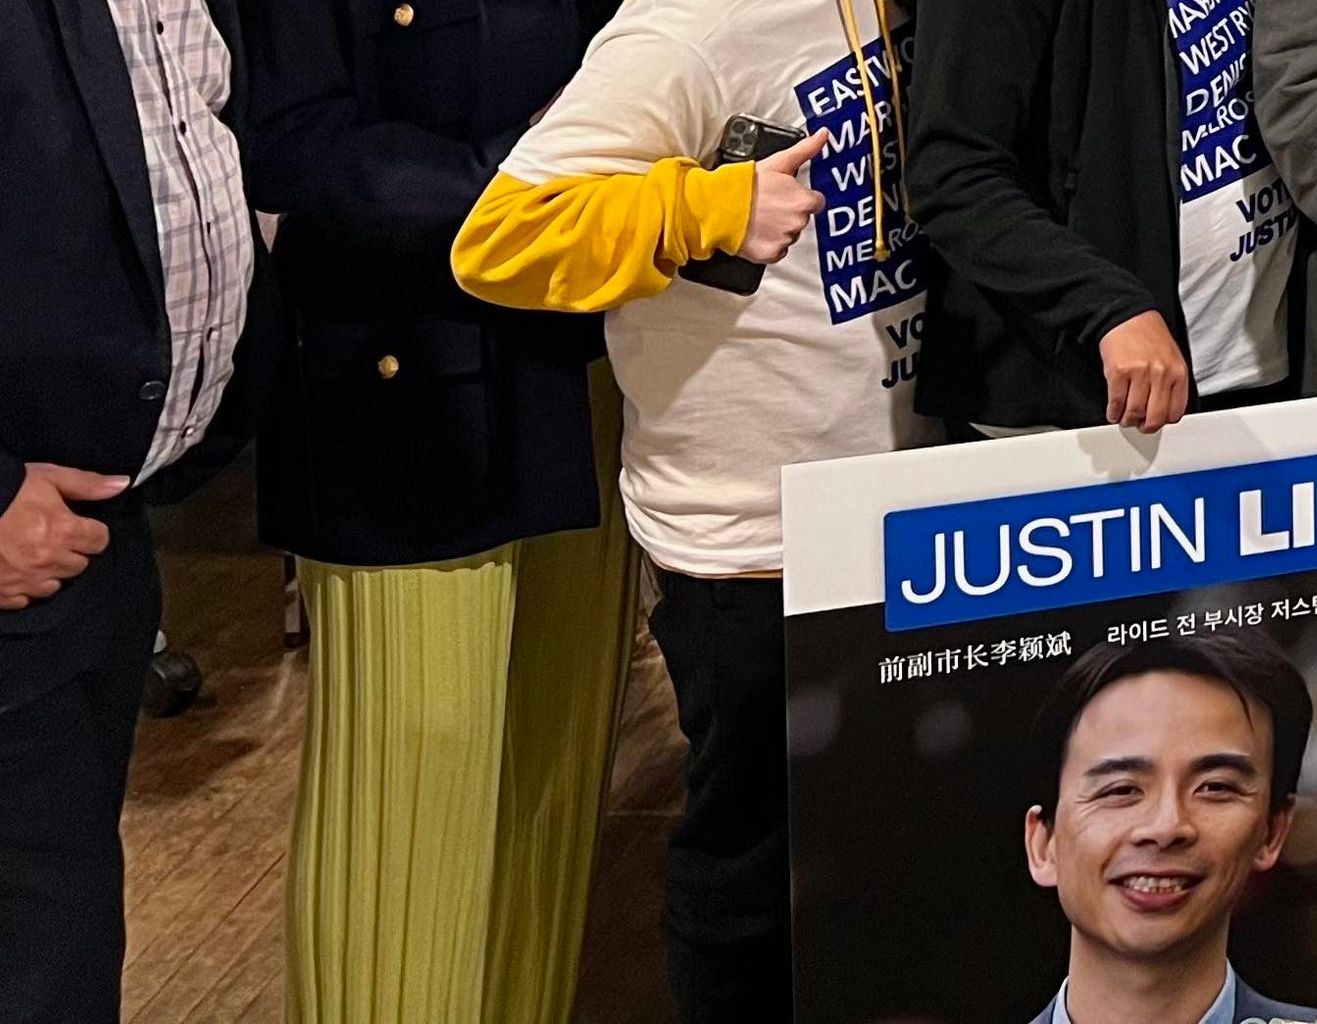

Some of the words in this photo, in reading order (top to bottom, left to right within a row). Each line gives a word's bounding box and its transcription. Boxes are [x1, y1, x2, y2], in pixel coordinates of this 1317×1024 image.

[1179, 18, 1235, 75] WEST
[1180, 134, 1257, 192] MAC
[1236, 177, 1291, 224] VOT
[829, 259, 917, 313] MAC
[901, 497, 1207, 605] JUSTIN
[1239, 481, 1315, 557] LI
[1107, 616, 1170, 645] 라이드
[1176, 612, 1197, 637] 전
[1203, 604, 1265, 633] 부시장
[878, 631, 1072, 684] 前副市长李颖斌
